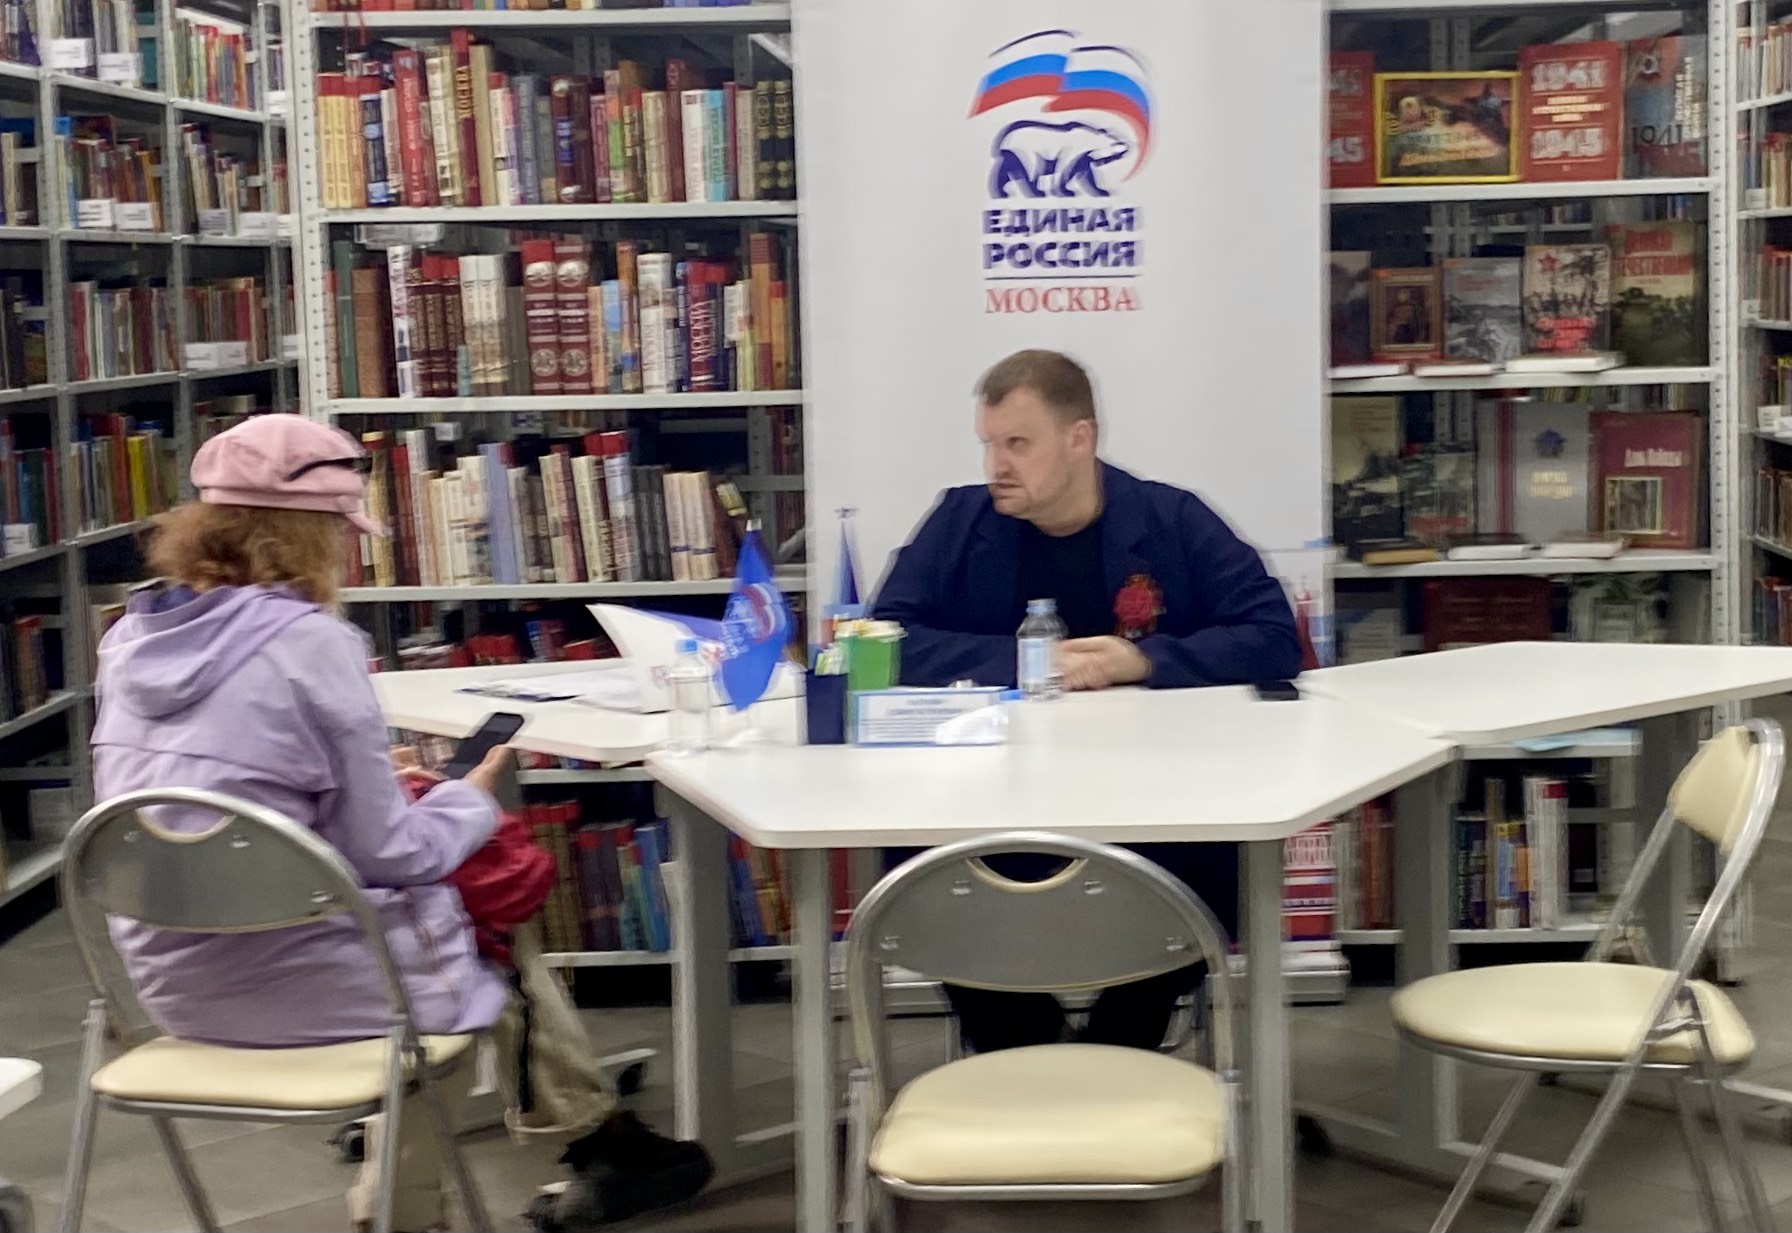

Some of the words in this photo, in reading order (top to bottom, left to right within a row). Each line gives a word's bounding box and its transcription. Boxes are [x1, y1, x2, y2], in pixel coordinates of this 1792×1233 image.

[454, 65, 473, 120] МОСКВА
[982, 207, 1140, 237] ЕДИНАЯ
[982, 240, 1140, 269] РОССИЯ
[985, 286, 1140, 313] МОСКВА
